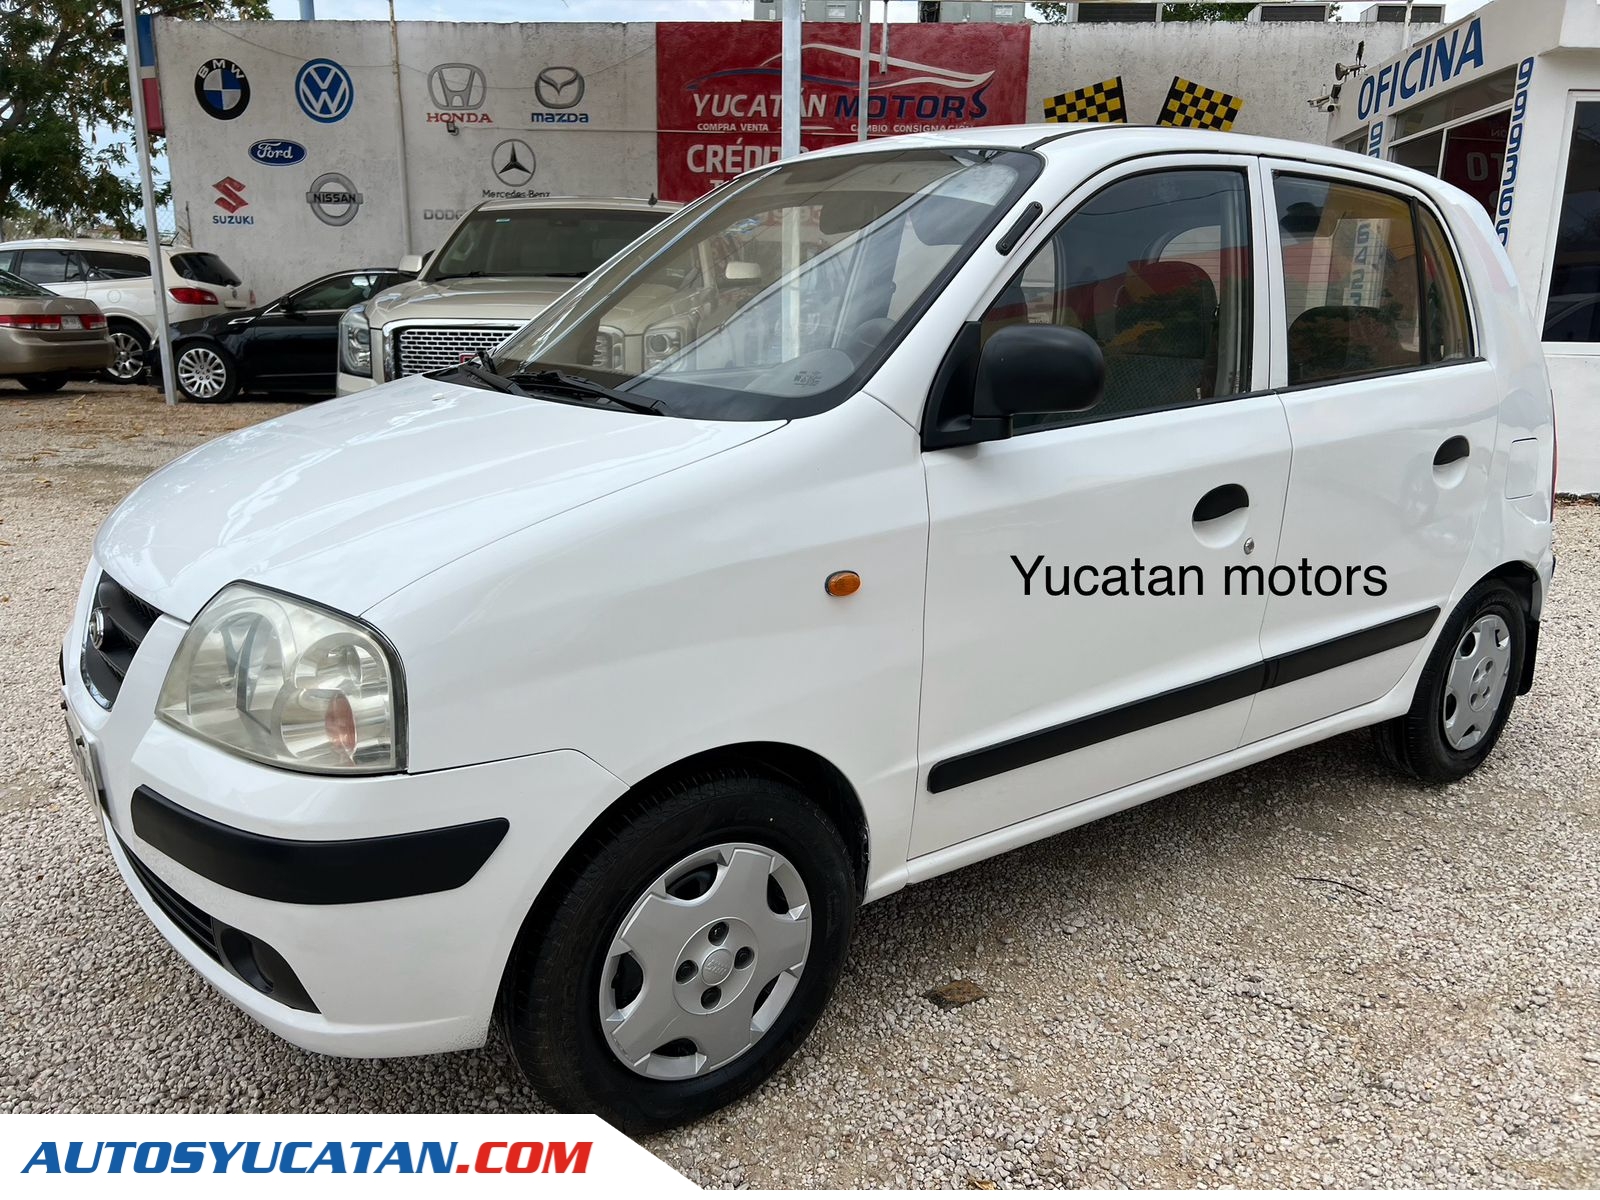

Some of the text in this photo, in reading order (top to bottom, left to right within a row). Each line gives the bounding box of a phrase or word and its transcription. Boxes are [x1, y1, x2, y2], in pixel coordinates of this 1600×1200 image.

[198, 59, 245, 79] BMW
[1357, 17, 1484, 121] OFICINA
[834, 80, 993, 119] MOTORS
[426, 112, 493, 123] HONDA
[697, 123, 737, 132] COMPRA
[741, 123, 769, 132] VENTA
[850, 124, 888, 133] CMBIO
[257, 142, 294, 159] Ford
[313, 193, 357, 204] NISSAN
[212, 215, 254, 226] SUZUKI
[423, 208, 467, 221] DODG
